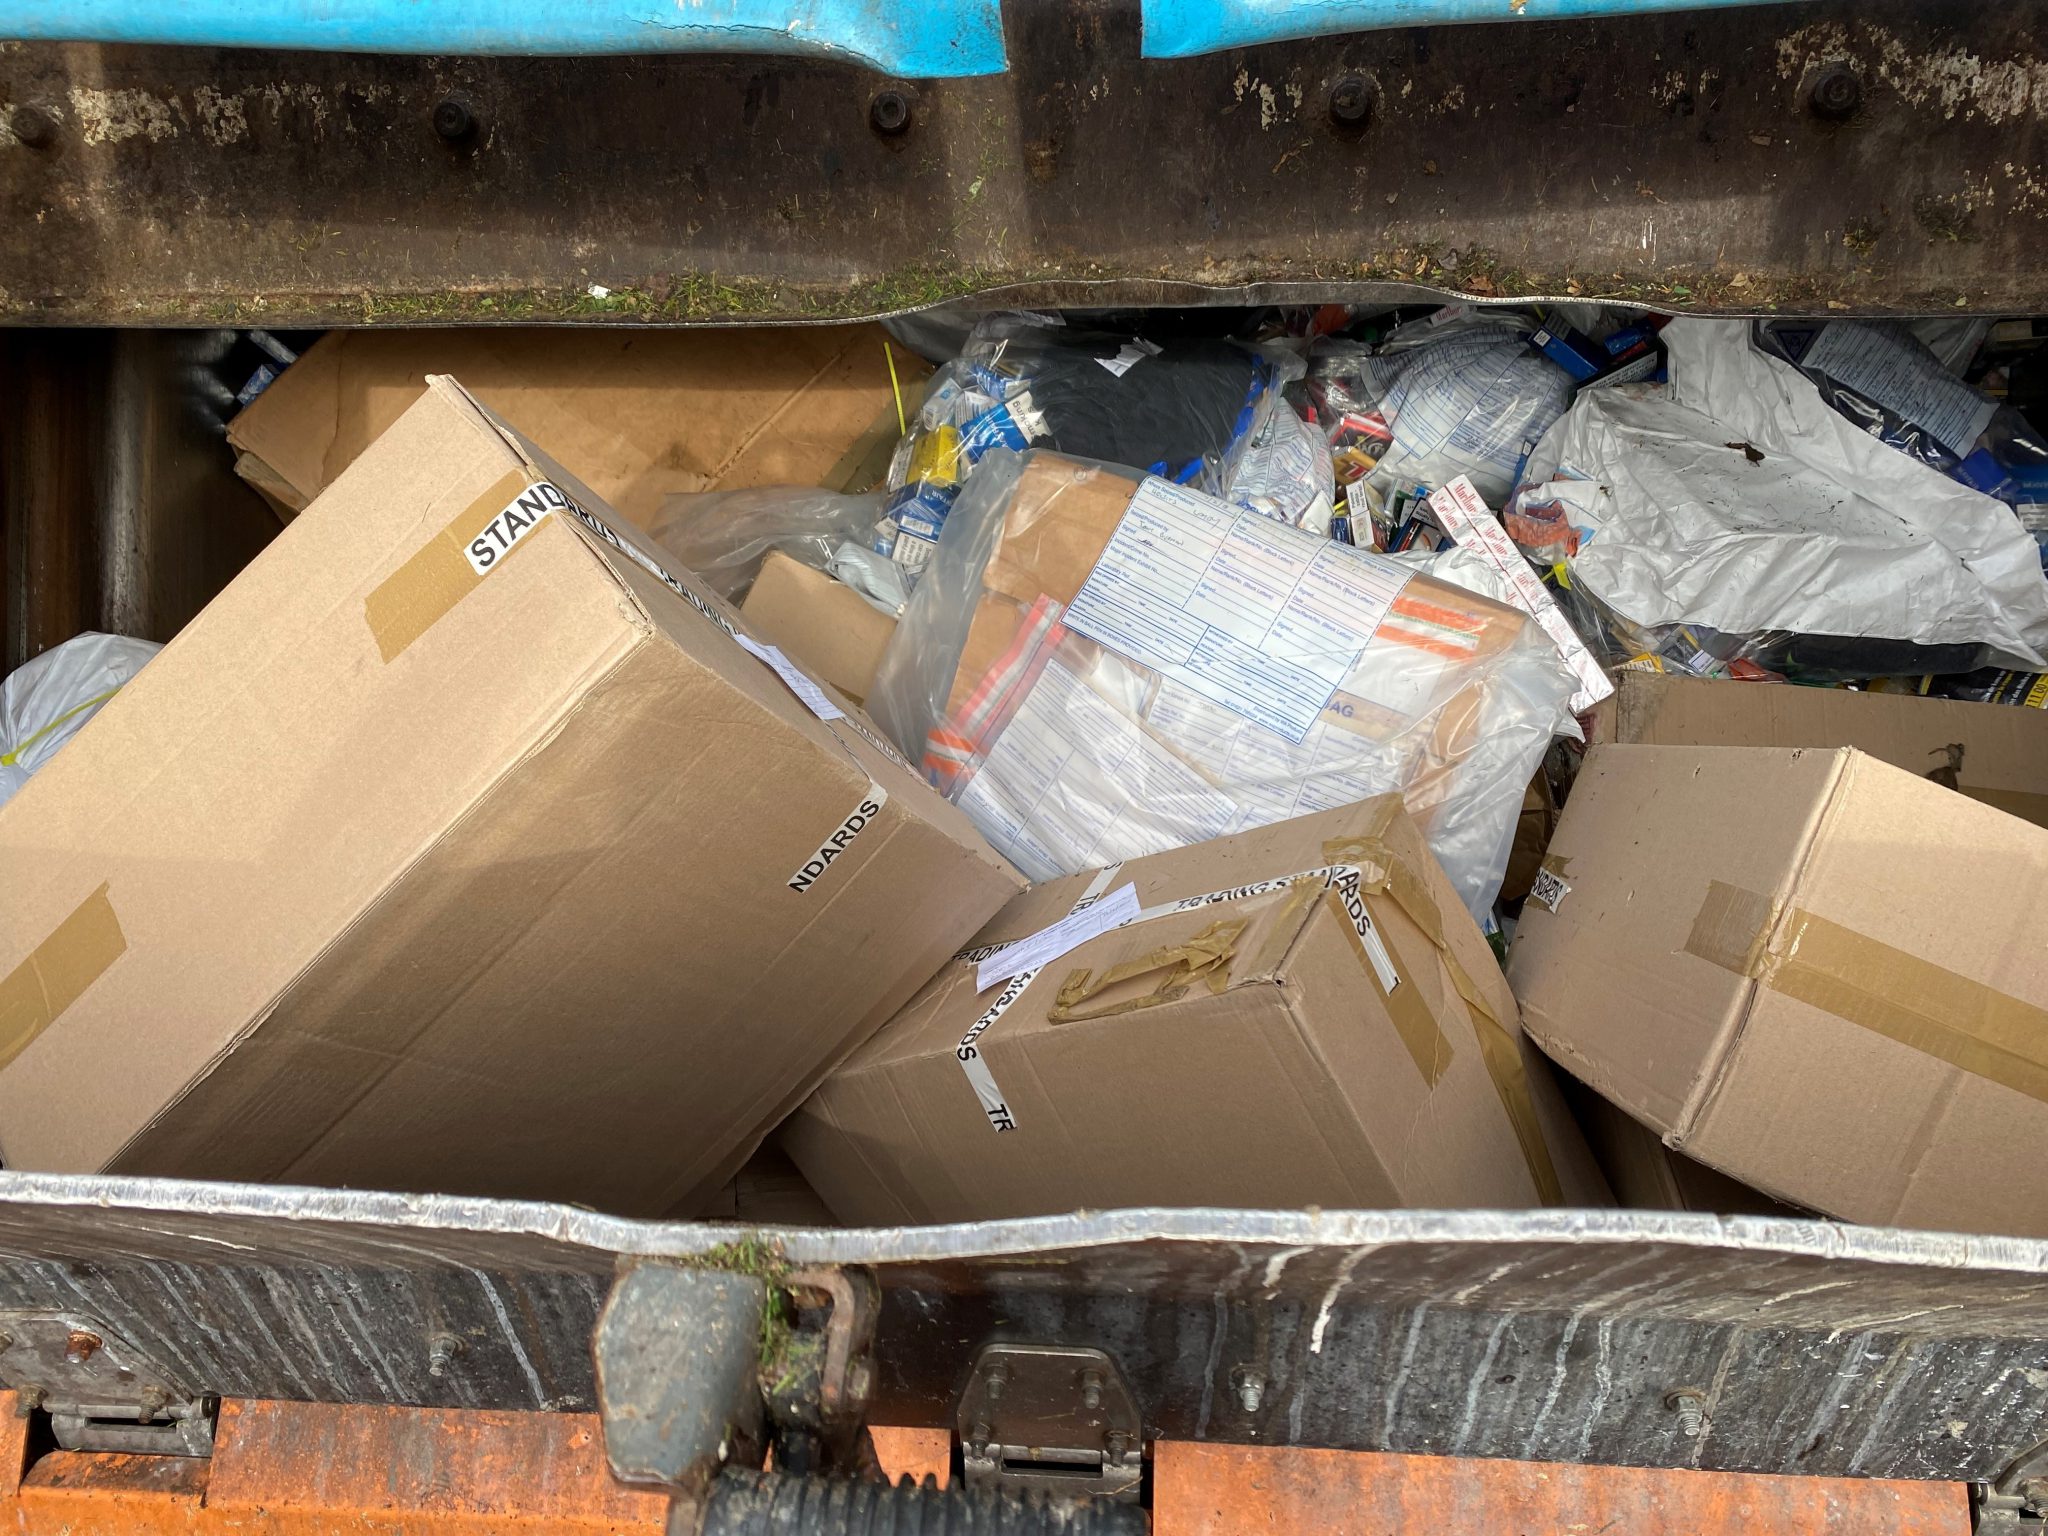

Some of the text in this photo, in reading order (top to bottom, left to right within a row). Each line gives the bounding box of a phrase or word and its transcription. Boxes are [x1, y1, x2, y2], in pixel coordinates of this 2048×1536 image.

[1011, 399, 1037, 440] moking
[1215, 556, 1226, 564] Date
[1313, 561, 1324, 569] Date
[1195, 590, 1206, 598] Date
[789, 800, 880, 893] NDARDS
